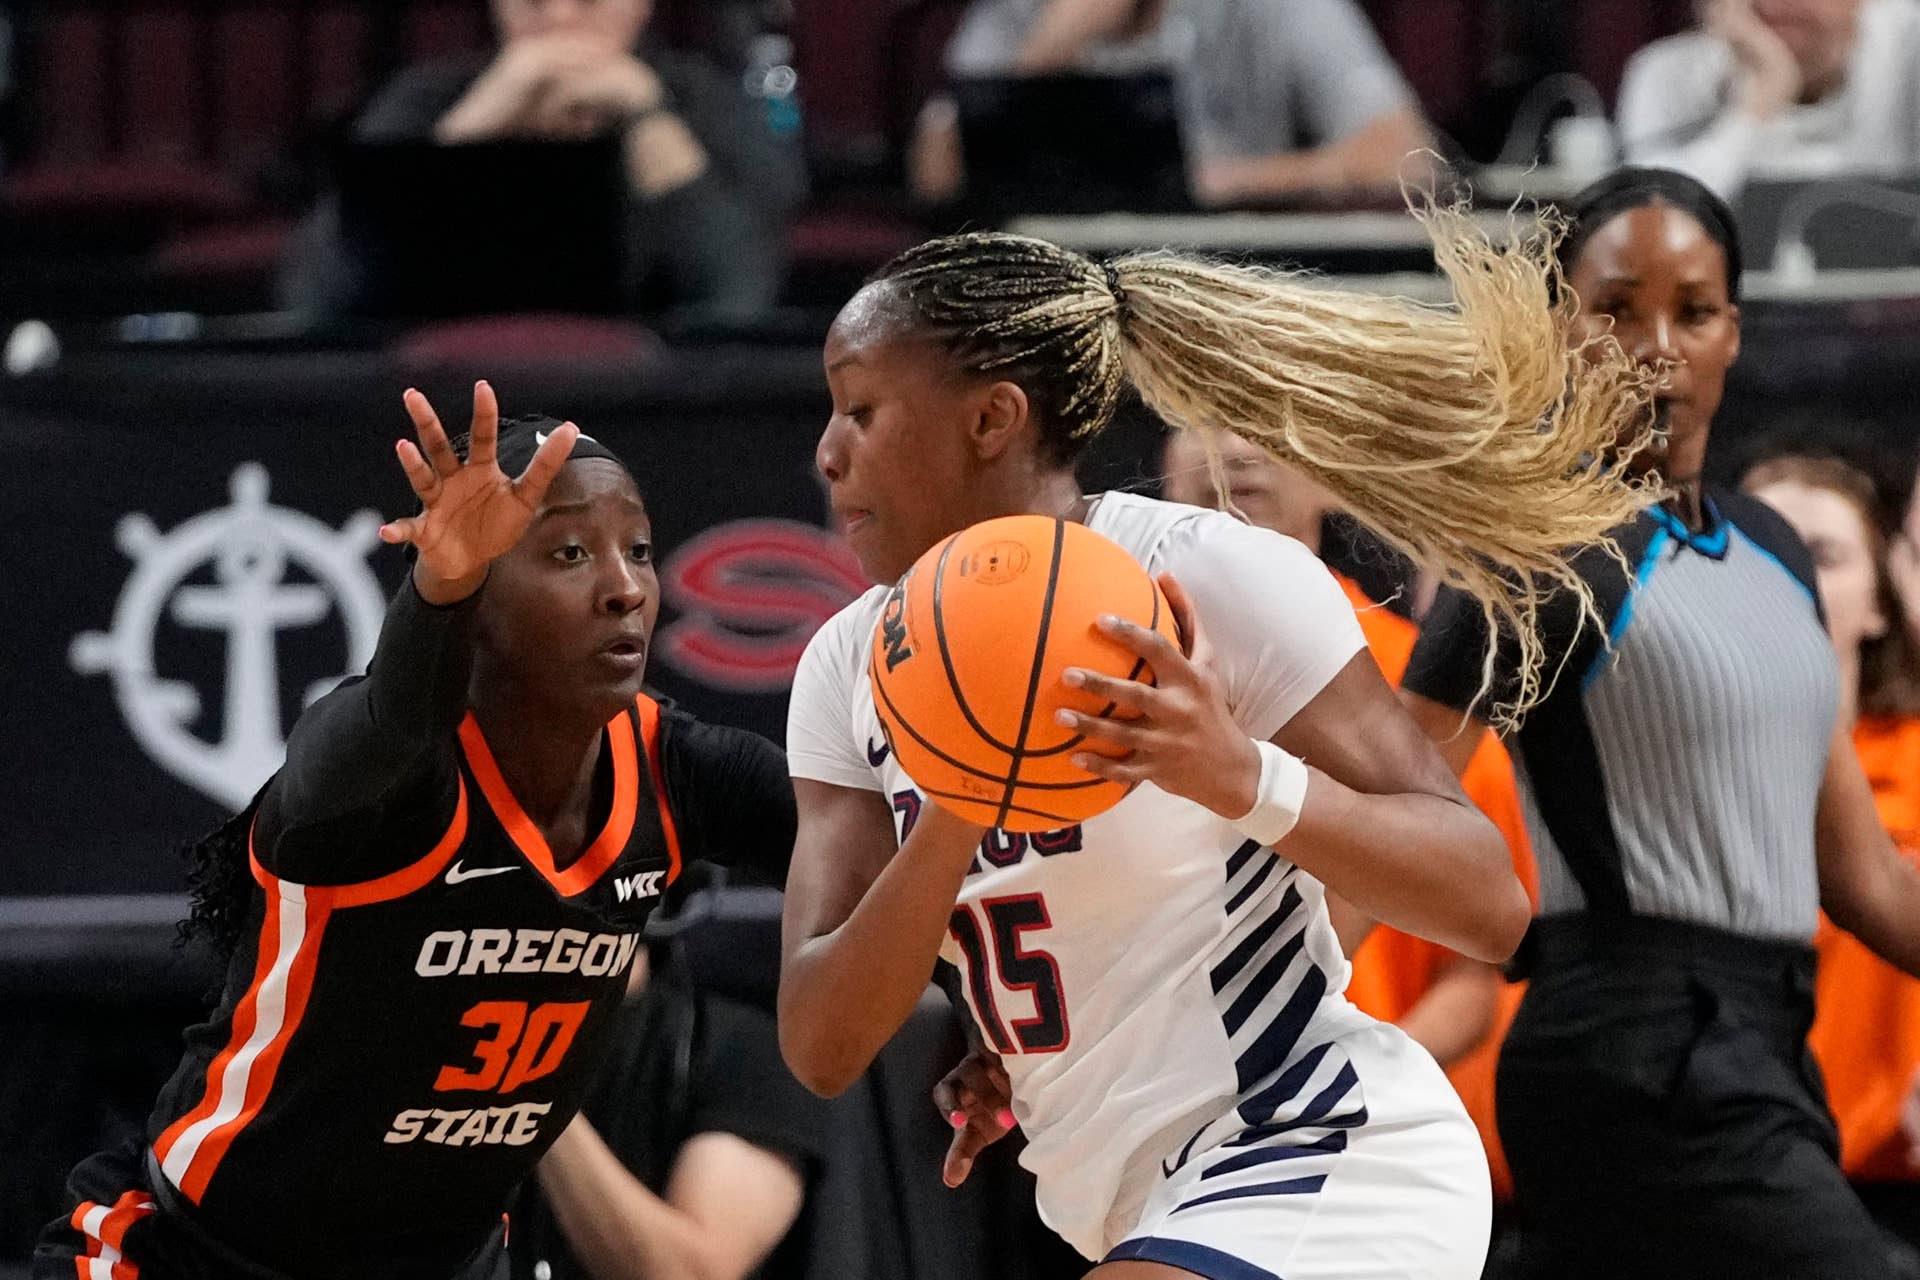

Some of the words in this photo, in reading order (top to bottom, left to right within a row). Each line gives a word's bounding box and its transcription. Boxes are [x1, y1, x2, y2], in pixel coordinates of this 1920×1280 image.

[614, 870, 666, 903] WCC
[414, 928, 640, 977] OREGON
[949, 892, 1071, 1055] 15
[432, 1001, 592, 1094] 30
[383, 1102, 553, 1147] STATE
